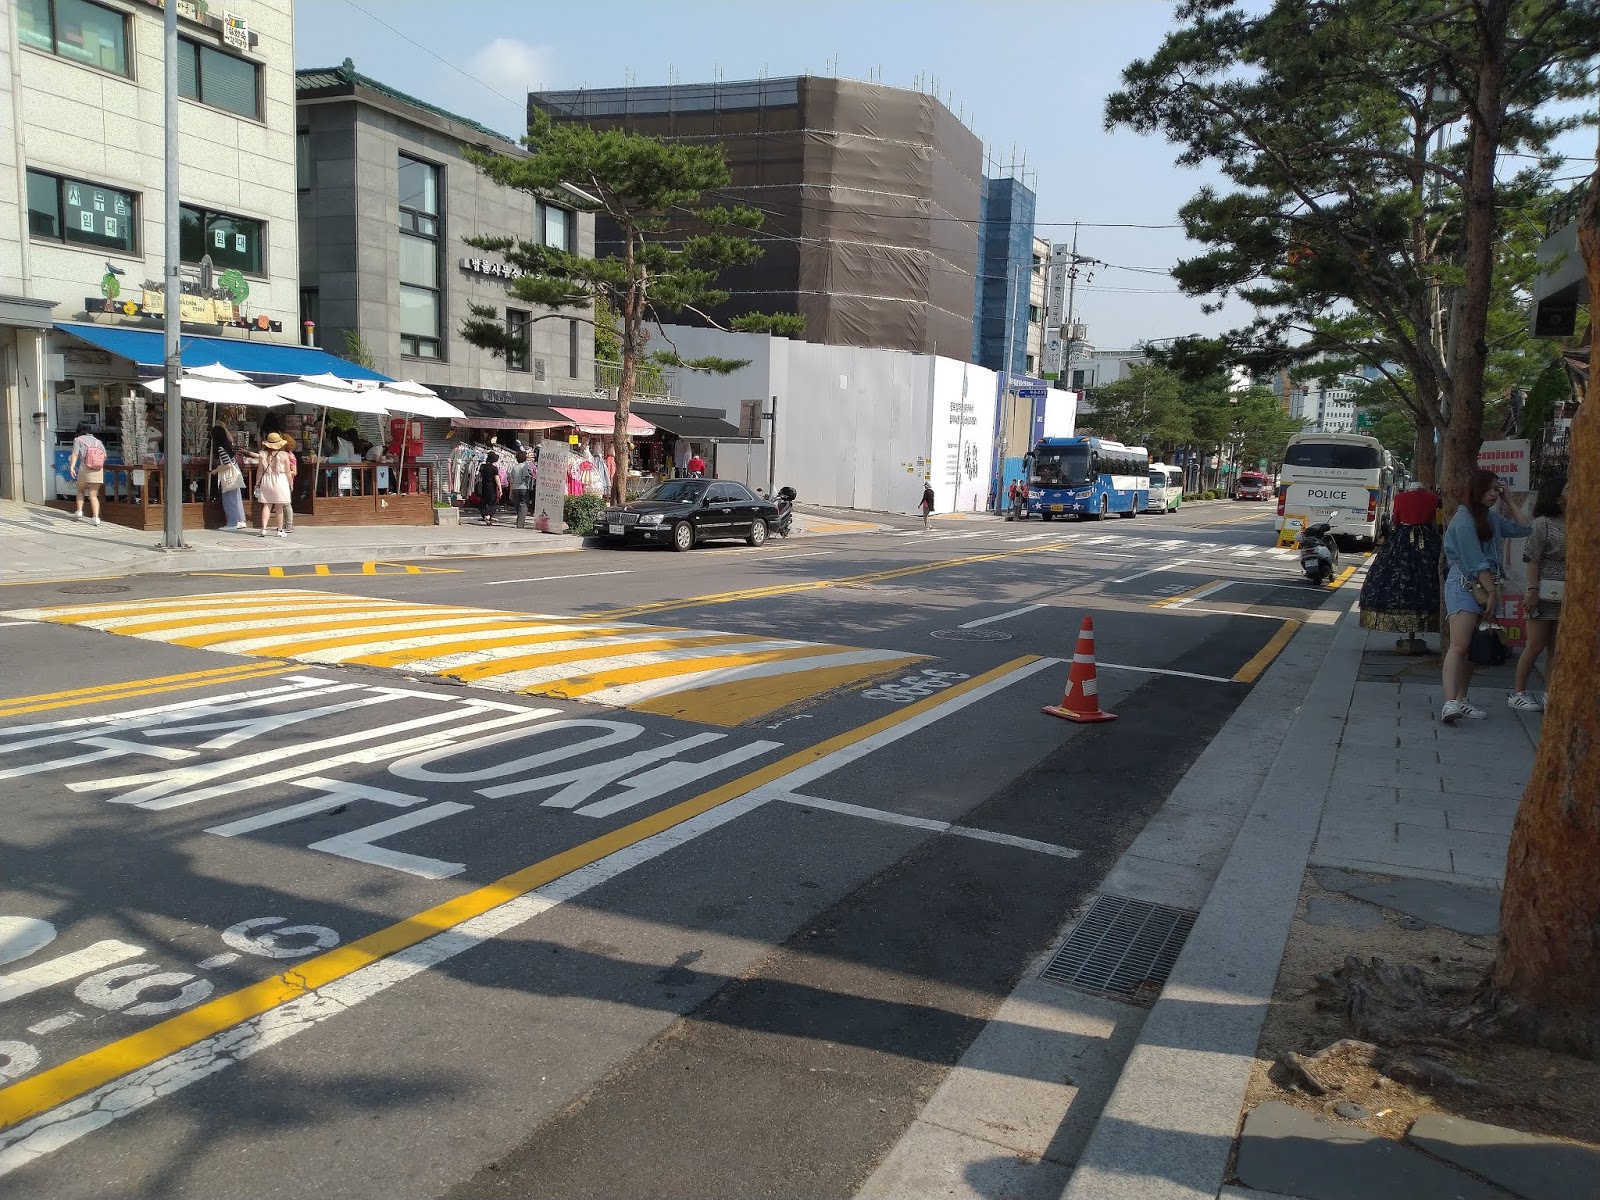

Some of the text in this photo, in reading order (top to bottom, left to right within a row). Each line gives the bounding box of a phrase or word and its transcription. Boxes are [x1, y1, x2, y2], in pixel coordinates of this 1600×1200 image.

[216, 232, 245, 249] 임대
[1477, 449, 1525, 460] emium
[1307, 489, 1348, 500] POLICE
